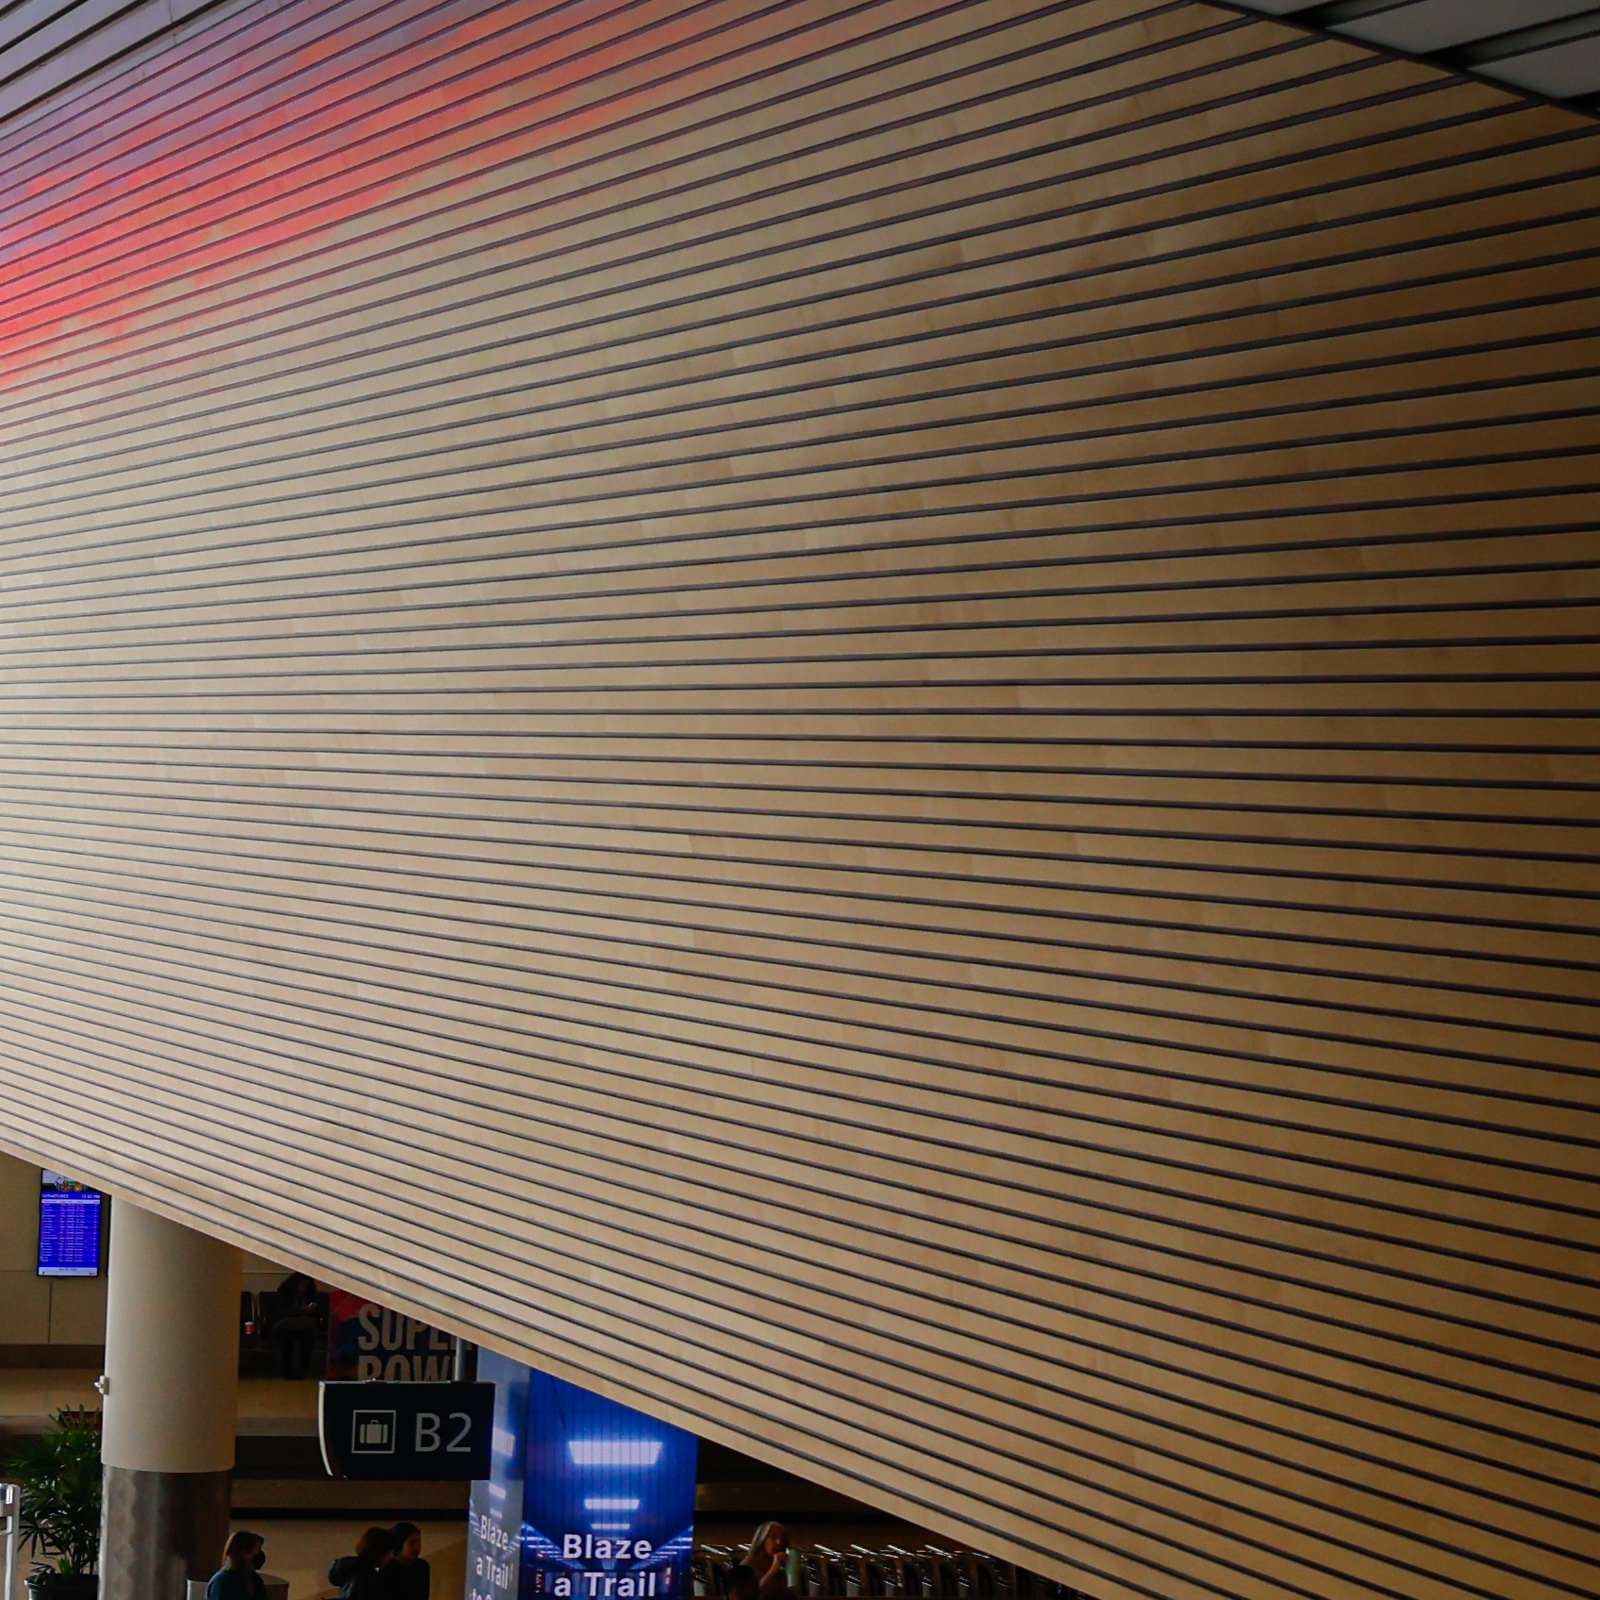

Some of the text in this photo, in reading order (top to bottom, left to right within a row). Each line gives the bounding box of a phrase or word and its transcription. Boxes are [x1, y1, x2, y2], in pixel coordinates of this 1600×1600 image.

[357, 1303, 472, 1352] SUPE
[357, 1354, 457, 1381] BOW
[415, 1412, 472, 1453] B2
[480, 1515, 509, 1551] Blaze
[563, 1533, 653, 1560] Blaze
[476, 1555, 509, 1590] a Trail
[554, 1571, 656, 1597] a Trail
